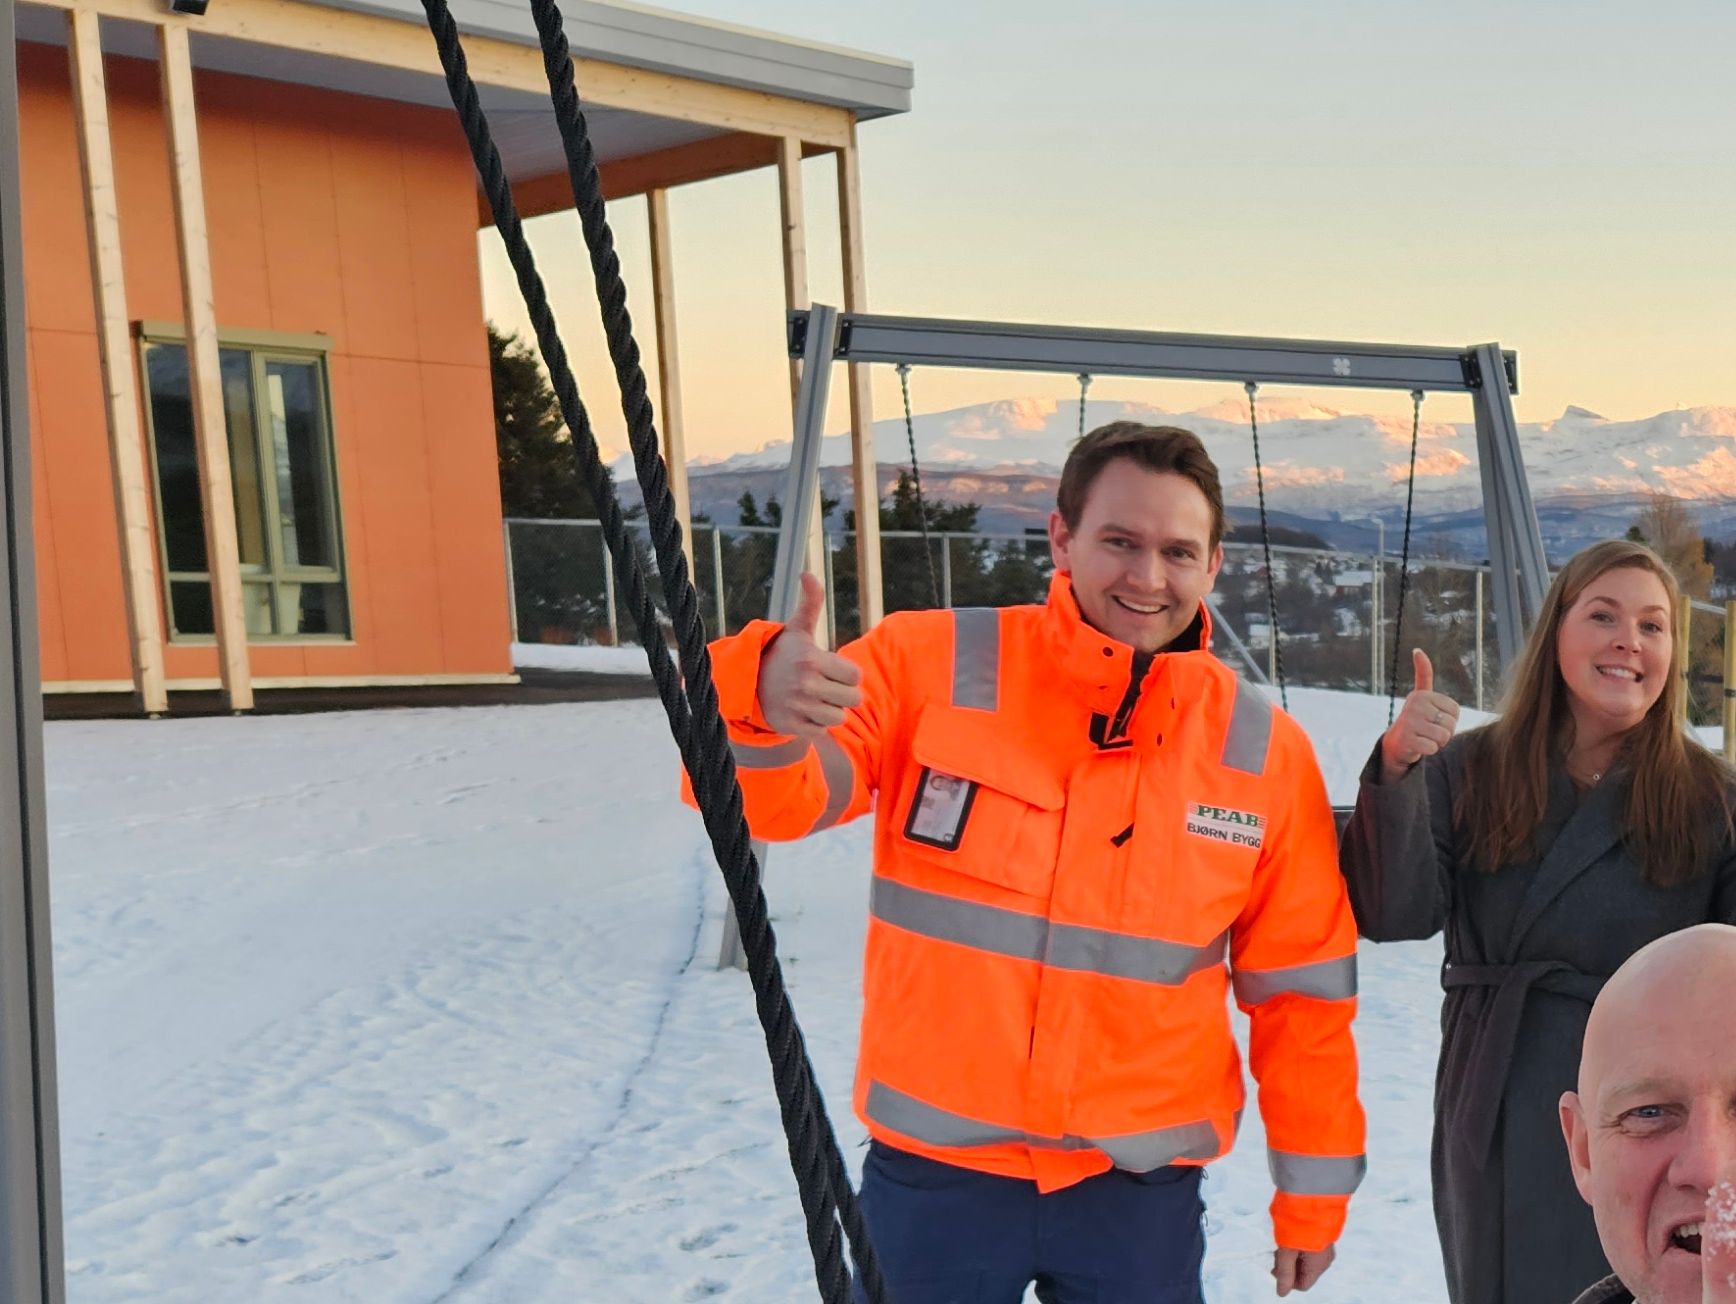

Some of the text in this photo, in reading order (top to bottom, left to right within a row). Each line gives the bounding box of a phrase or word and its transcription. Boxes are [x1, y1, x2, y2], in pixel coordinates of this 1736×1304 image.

[1197, 804, 1259, 827] PEAB
[1186, 822, 1262, 848] BJØRN BYGG
